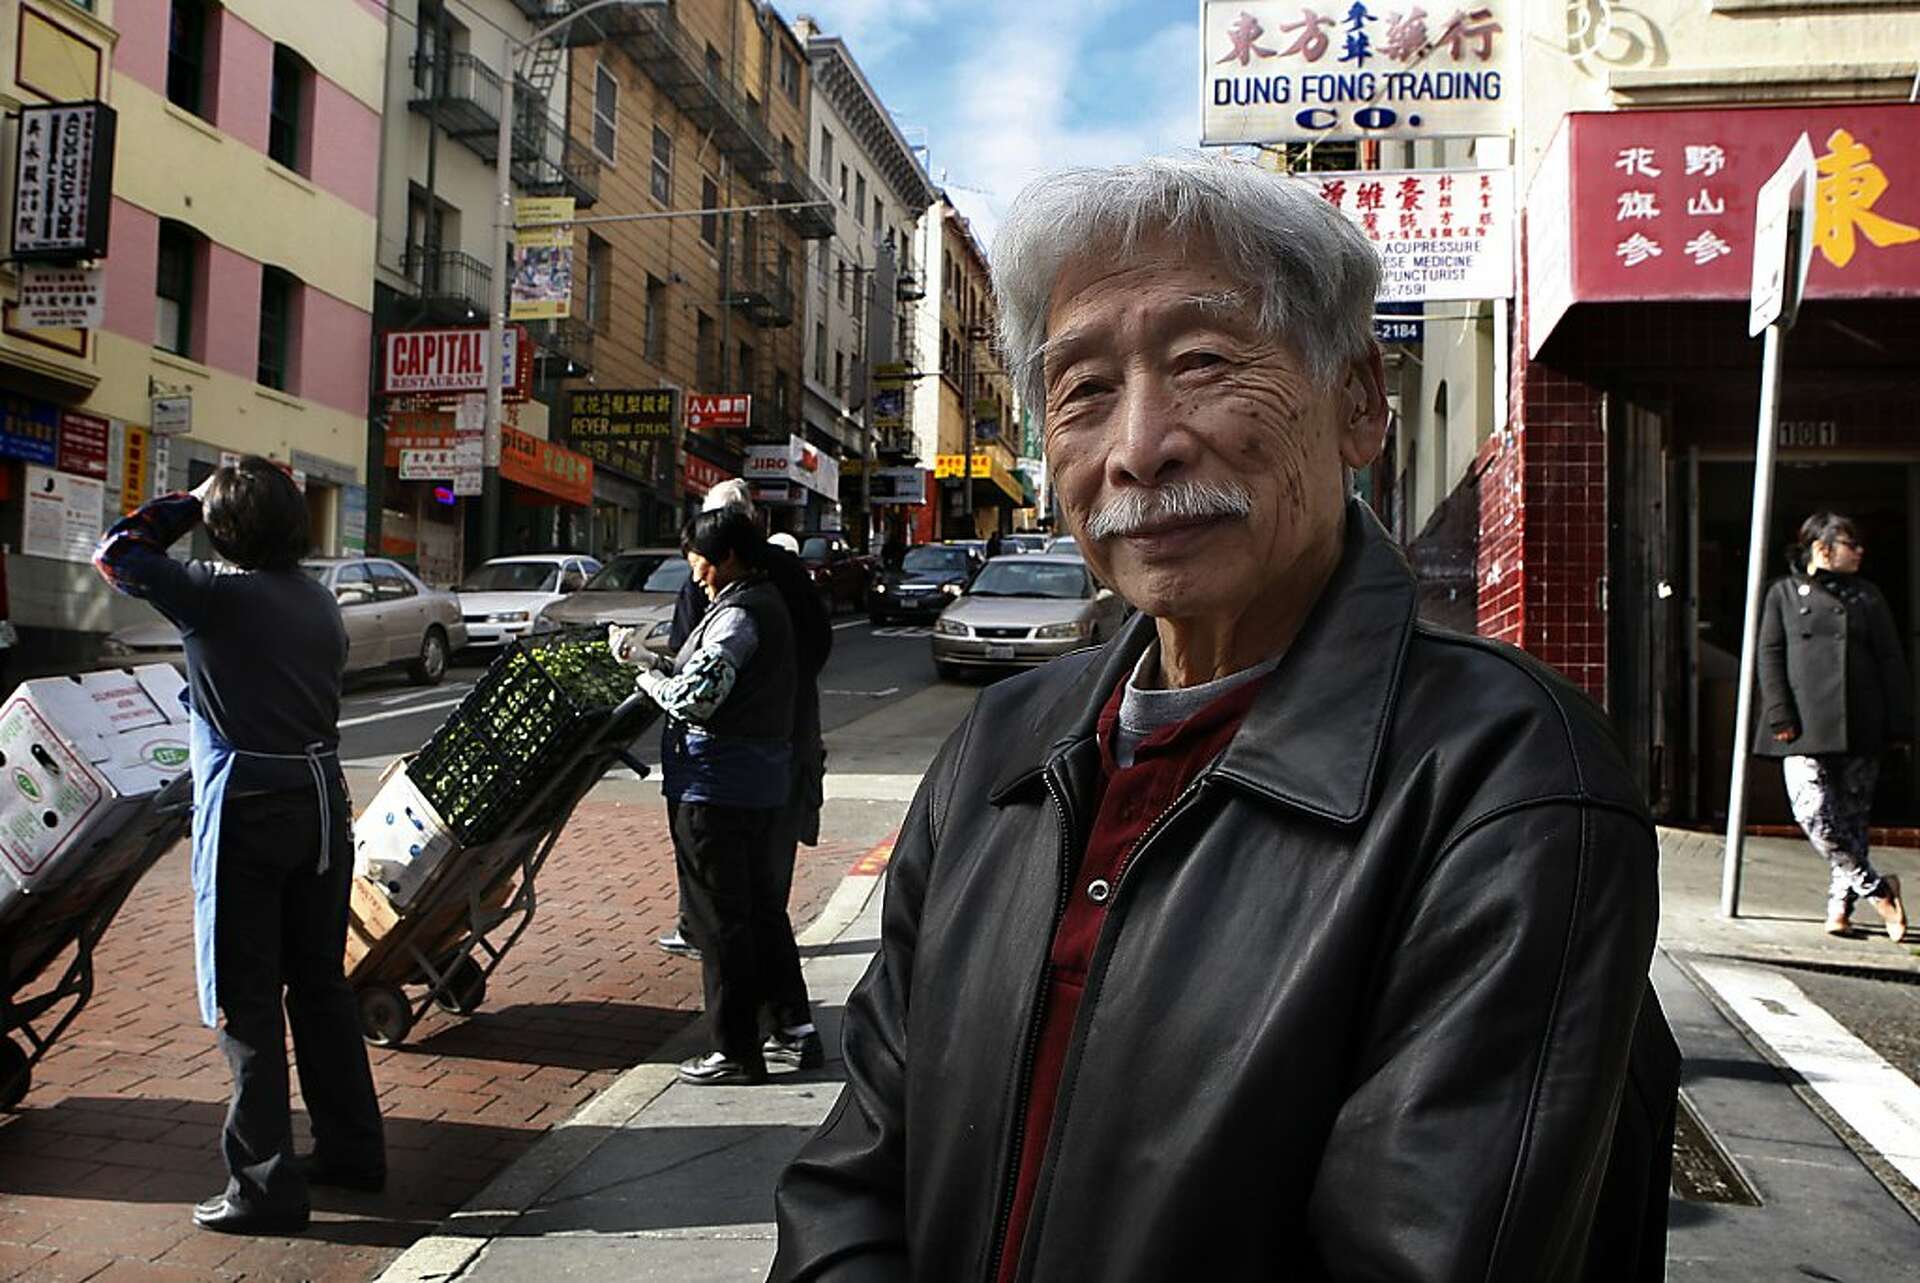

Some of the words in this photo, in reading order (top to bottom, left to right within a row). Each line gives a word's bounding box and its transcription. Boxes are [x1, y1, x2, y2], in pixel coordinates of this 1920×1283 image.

[1213, 76, 1292, 106] DUNG
[1301, 73, 1375, 103] FONG
[1385, 71, 1502, 101] TRADING
[1295, 107, 1421, 130] CO.
[1384, 241, 1481, 254] ACUPRESSURE
[1413, 255, 1473, 268] MEDICINE
[392, 333, 483, 377] CAPITAL
[391, 374, 484, 389] RESTAURANT
[752, 457, 788, 470] JIRO
